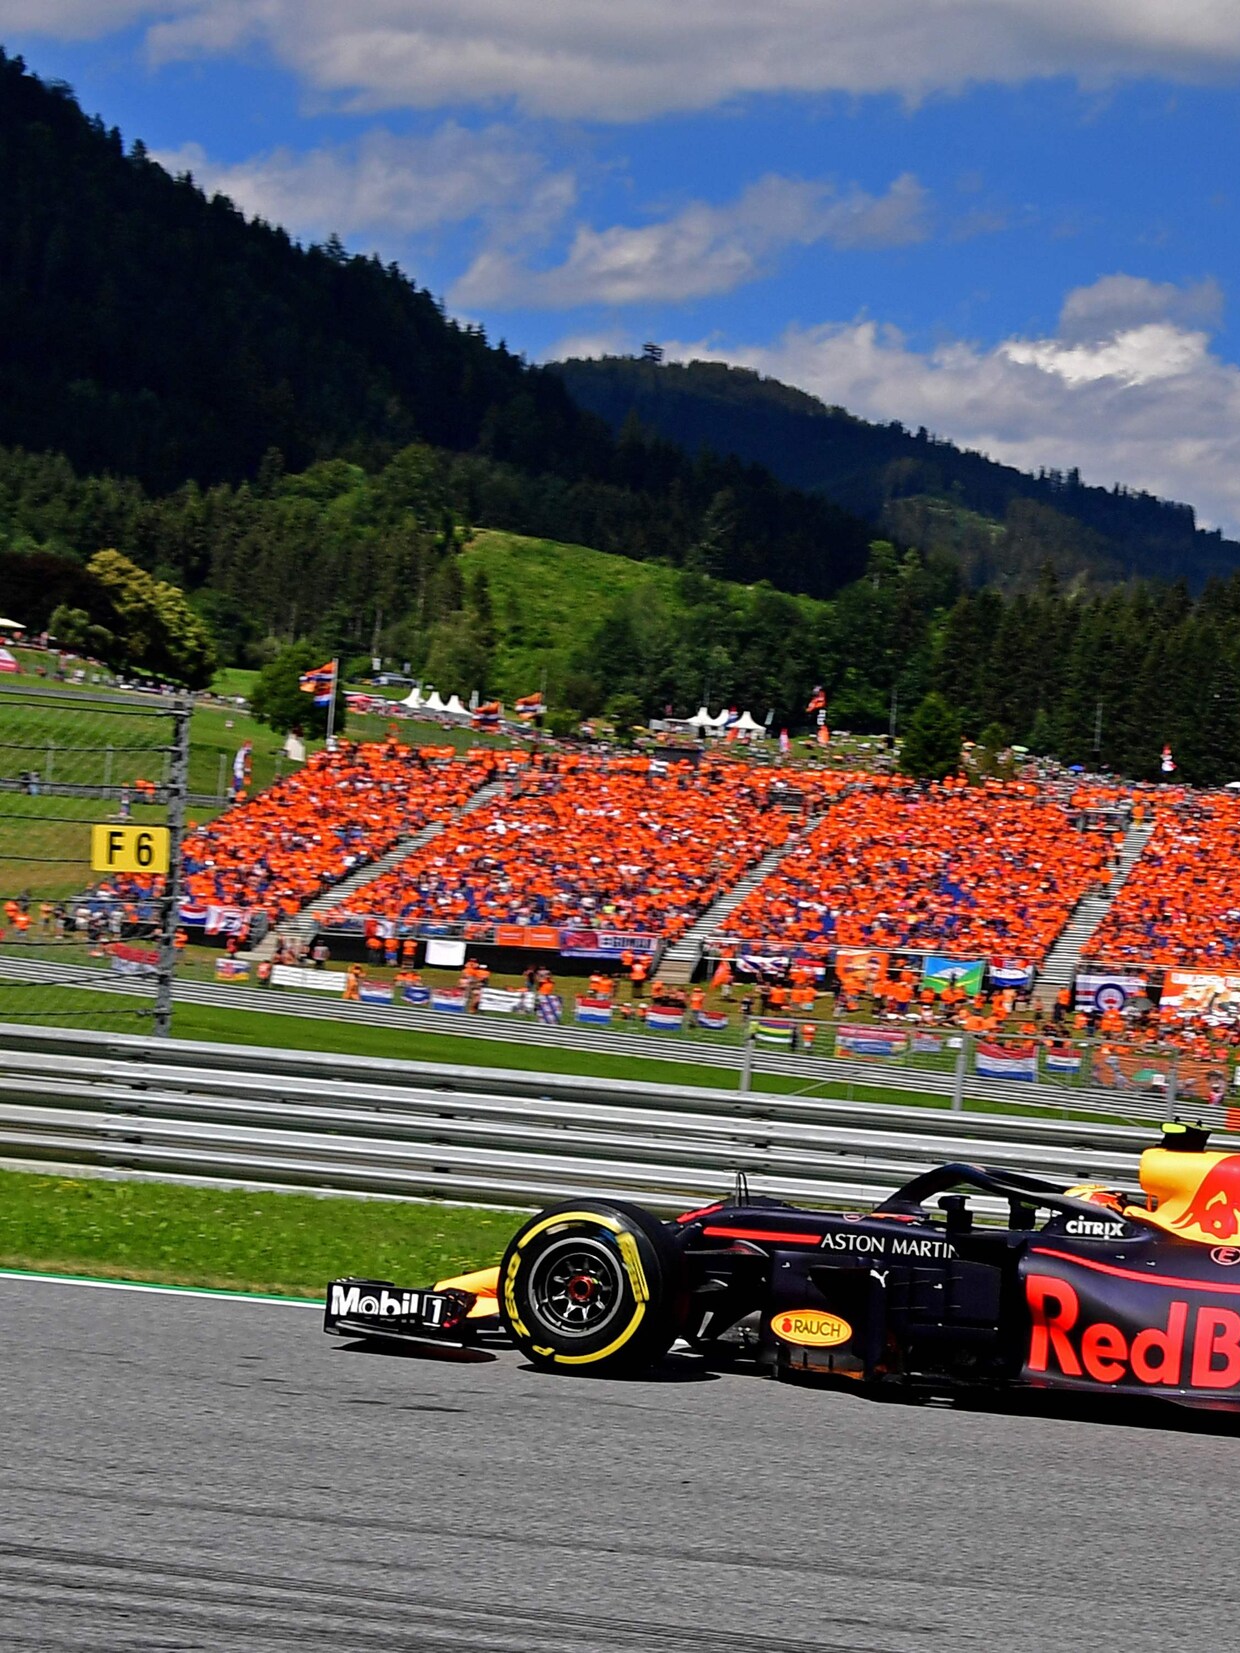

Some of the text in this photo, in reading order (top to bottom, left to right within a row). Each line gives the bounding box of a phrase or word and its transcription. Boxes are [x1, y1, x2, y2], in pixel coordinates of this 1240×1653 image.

[107, 831, 154, 866] F 6
[821, 1232, 885, 1253] ASTON
[330, 1284, 442, 1323] Mobil 1
[793, 1319, 841, 1338] RAUCH
